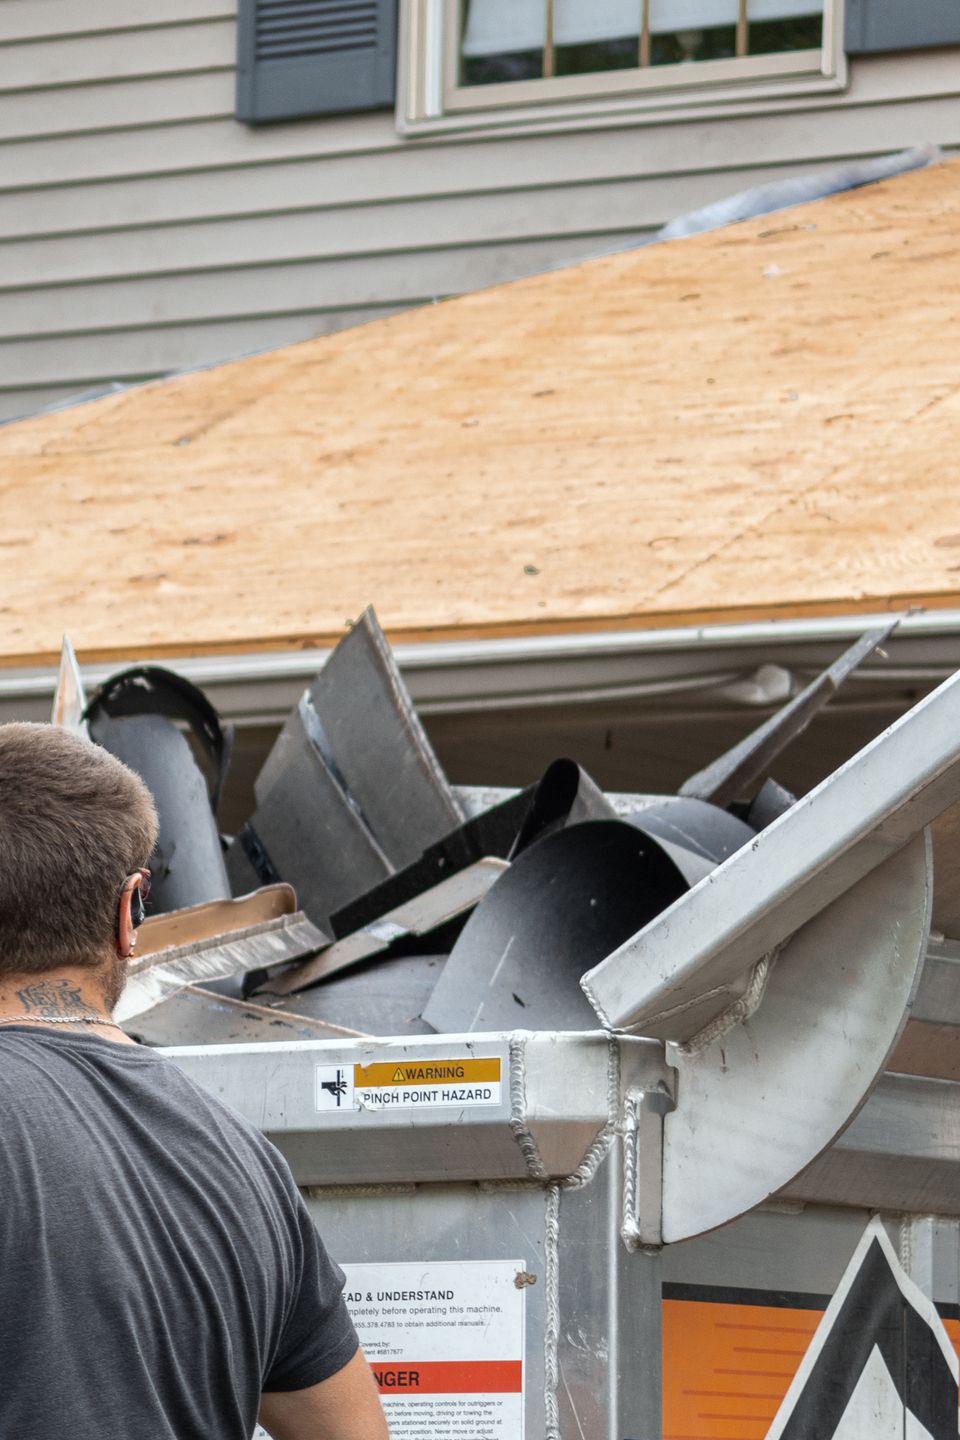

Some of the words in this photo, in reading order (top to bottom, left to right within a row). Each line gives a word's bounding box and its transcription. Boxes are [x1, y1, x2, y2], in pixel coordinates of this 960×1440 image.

[406, 1066, 464, 1080] WARNING
[364, 1092, 399, 1103] PINCH
[403, 1091, 438, 1102] POINT
[442, 1089, 492, 1100] HAZARD
[342, 1293, 362, 1302] EAD
[366, 1292, 373, 1301] &
[377, 1291, 454, 1301] UNDERSTAND
[409, 1306, 447, 1316] operating
[466, 1305, 503, 1313] machine.
[374, 1372, 419, 1386] NGER
[413, 1410, 434, 1418] moving,
[428, 1419, 451, 1427] securely
